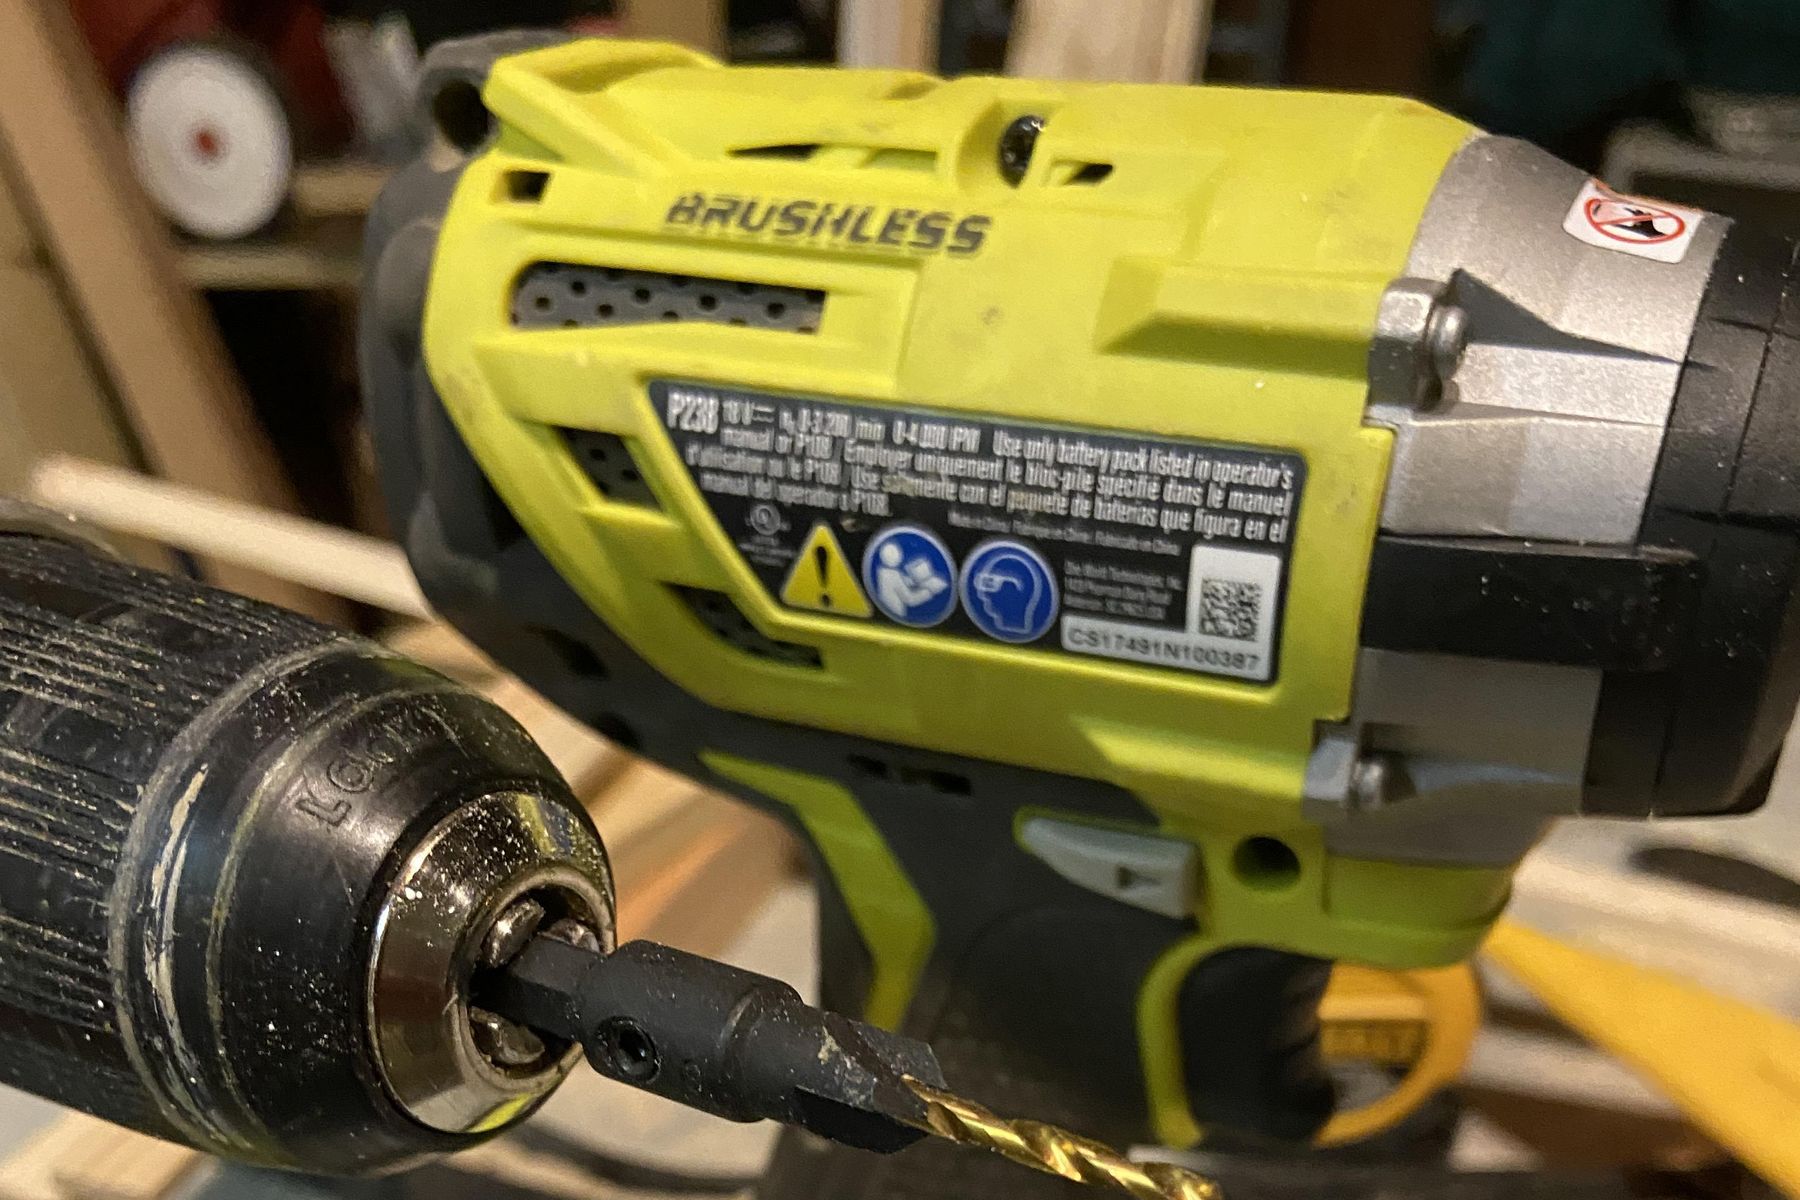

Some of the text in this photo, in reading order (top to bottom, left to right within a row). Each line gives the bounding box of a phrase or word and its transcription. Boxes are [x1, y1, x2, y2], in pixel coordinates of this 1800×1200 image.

[665, 192, 993, 254] BRUSHLESS
[914, 451, 1004, 482] uniquement
[1163, 477, 1204, 506] dans
[1206, 482, 1226, 509] le
[1227, 490, 1293, 517] manuel
[993, 428, 1023, 458] Use
[1023, 434, 1055, 467] only
[1057, 437, 1110, 473] battery
[1110, 446, 1148, 474] pack
[1150, 448, 1194, 478] listed
[1212, 461, 1293, 490] operator's
[1070, 494, 1092, 519] de
[1159, 508, 1192, 535] que
[1193, 507, 1242, 540] figura
[1244, 517, 1268, 542] en
[1269, 517, 1290, 543] el
